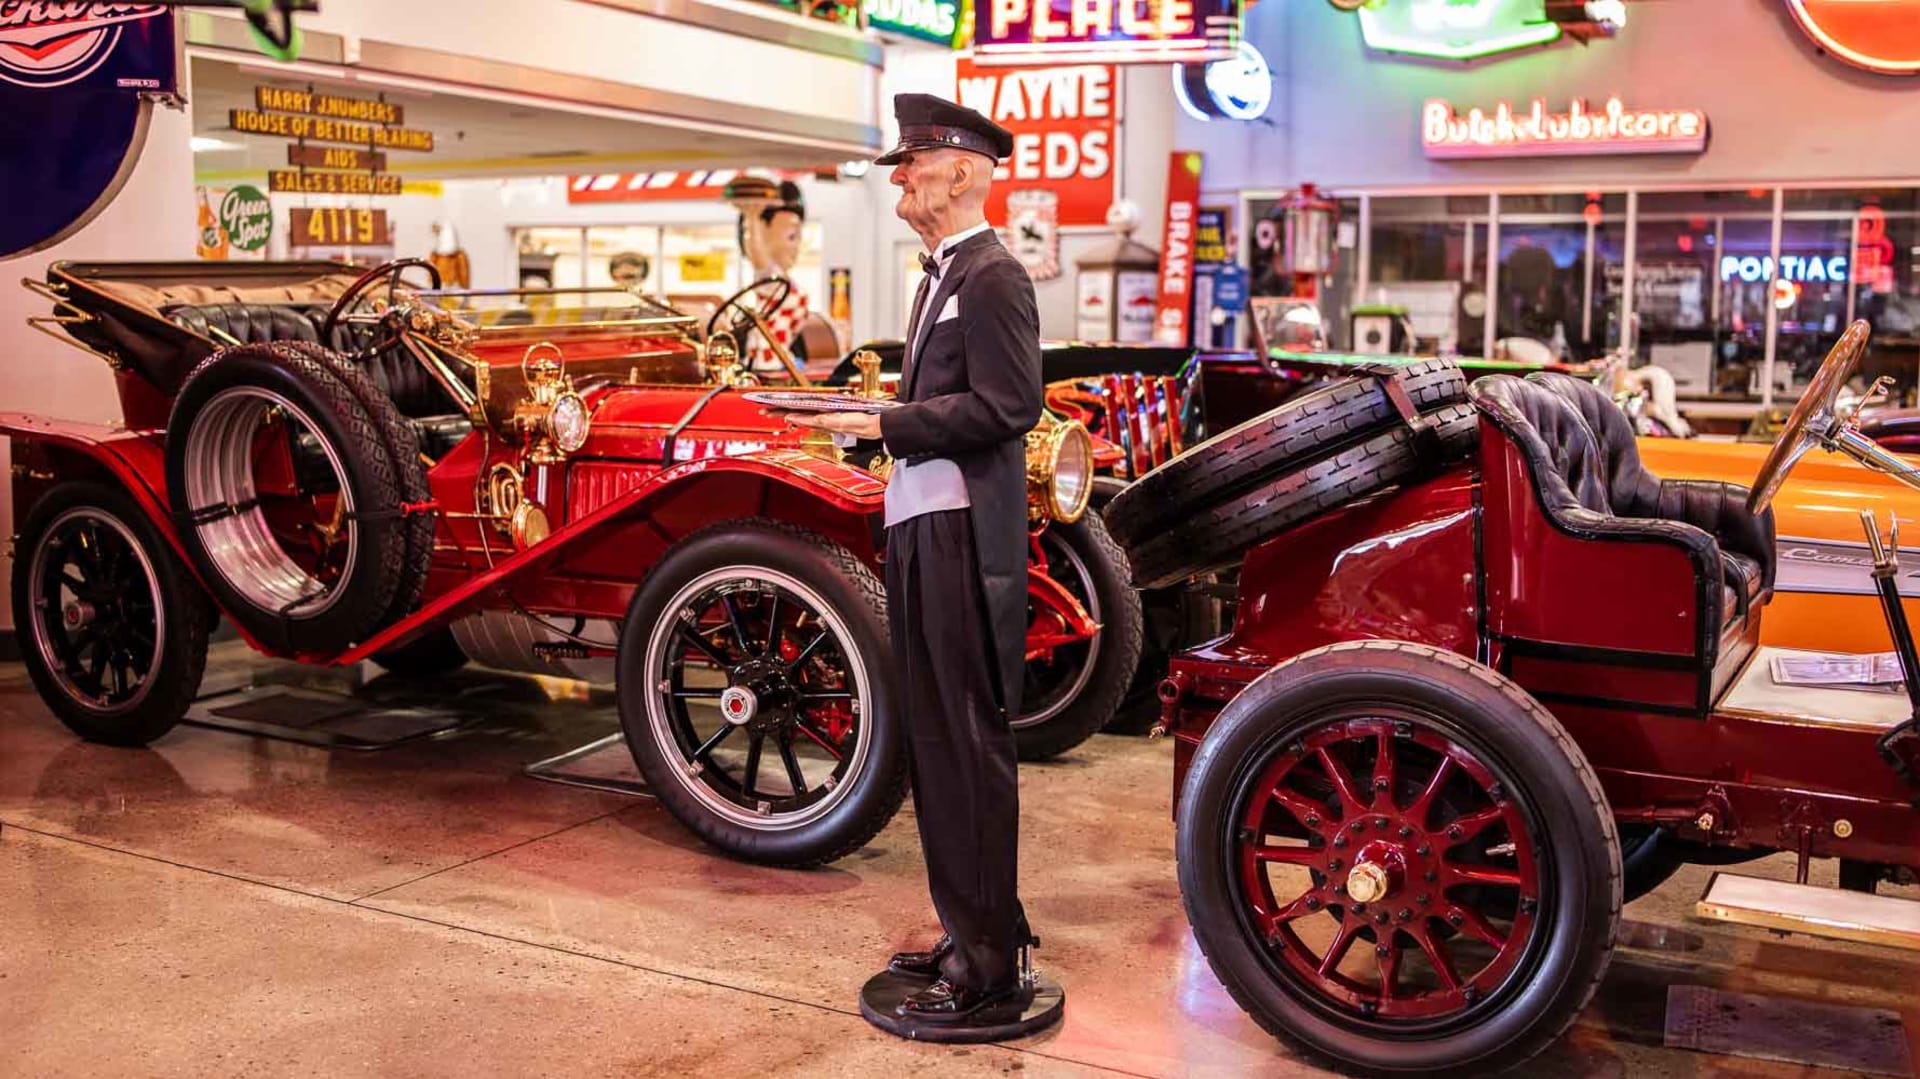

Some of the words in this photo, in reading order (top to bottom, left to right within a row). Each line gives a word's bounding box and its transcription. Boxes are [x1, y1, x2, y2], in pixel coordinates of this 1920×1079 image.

[990, 0, 1194, 39] PLACE
[261, 87, 313, 113] HARRY
[959, 65, 1110, 121] WAYNE
[236, 111, 286, 134] HOUSE
[292, 119, 310, 136] OF
[316, 120, 369, 143] BETTER
[323, 149, 358, 168] AIDS
[993, 130, 1110, 181] EDS
[326, 176, 336, 192] &
[341, 176, 399, 193] SERVICE
[223, 192, 269, 232] Green
[308, 209, 373, 243] 4119
[233, 218, 270, 248] Spot
[1163, 201, 1192, 294] BRAKE
[1720, 256, 1847, 282] PONTIAC
